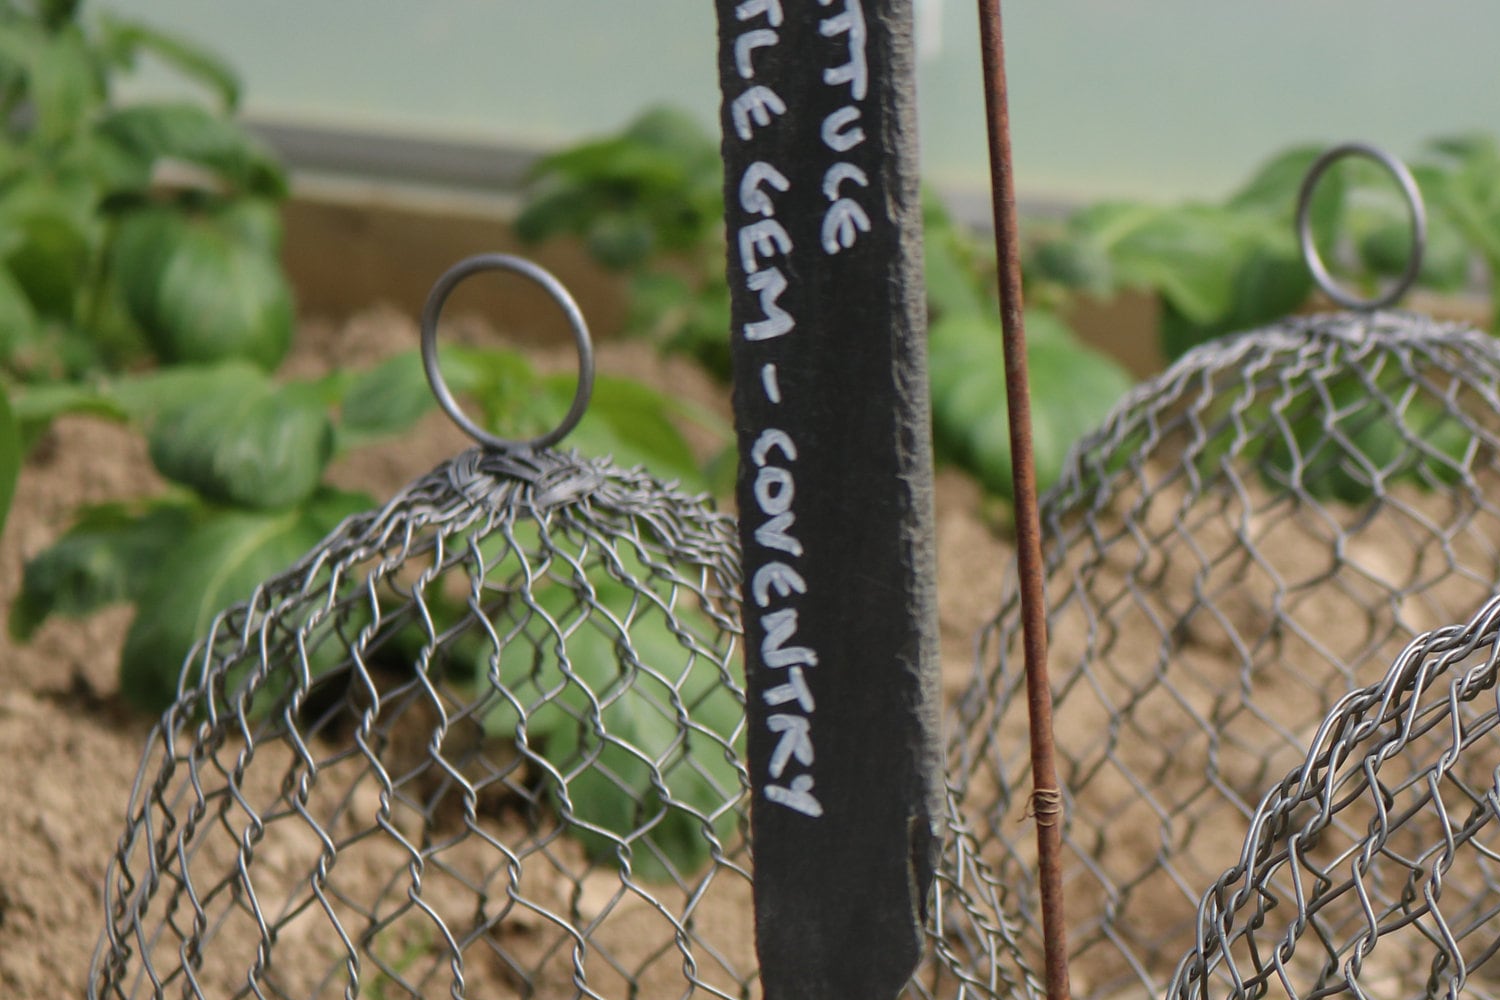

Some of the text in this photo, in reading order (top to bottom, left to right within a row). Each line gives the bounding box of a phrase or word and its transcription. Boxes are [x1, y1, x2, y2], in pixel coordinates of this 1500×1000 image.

[738, 160, 797, 341] GEM
[818, 0, 871, 255] TTUCE
[751, 428, 824, 818] COVENTRY
